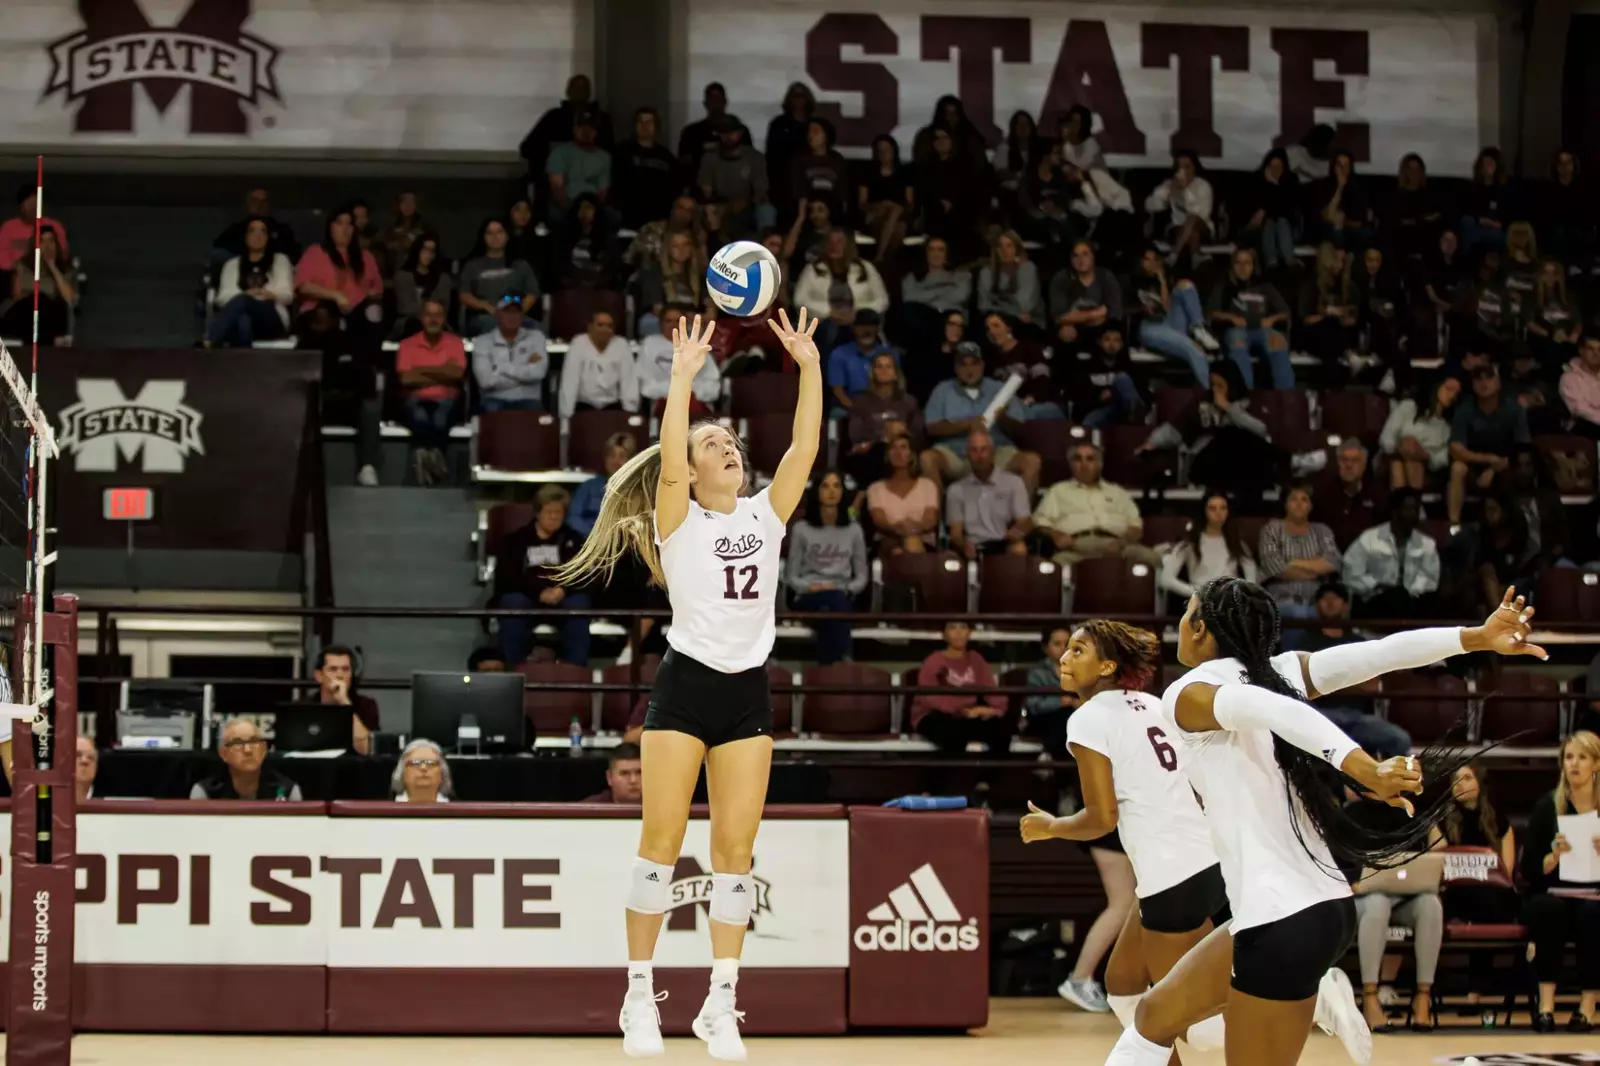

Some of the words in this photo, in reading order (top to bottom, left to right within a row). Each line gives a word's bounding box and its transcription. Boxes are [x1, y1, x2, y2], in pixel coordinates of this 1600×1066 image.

[86, 38, 236, 84] STATE
[805, 13, 1370, 161] STATE
[709, 257, 739, 281] molten
[84, 408, 175, 438] STATE
[713, 533, 764, 562] State
[723, 564, 760, 600] 12
[1147, 726, 1178, 772] 6
[250, 855, 561, 928] STATE
[672, 878, 713, 903] STA
[33, 890, 51, 944] sports
[854, 918, 980, 951] adidas
[31, 946, 48, 1011] imports
